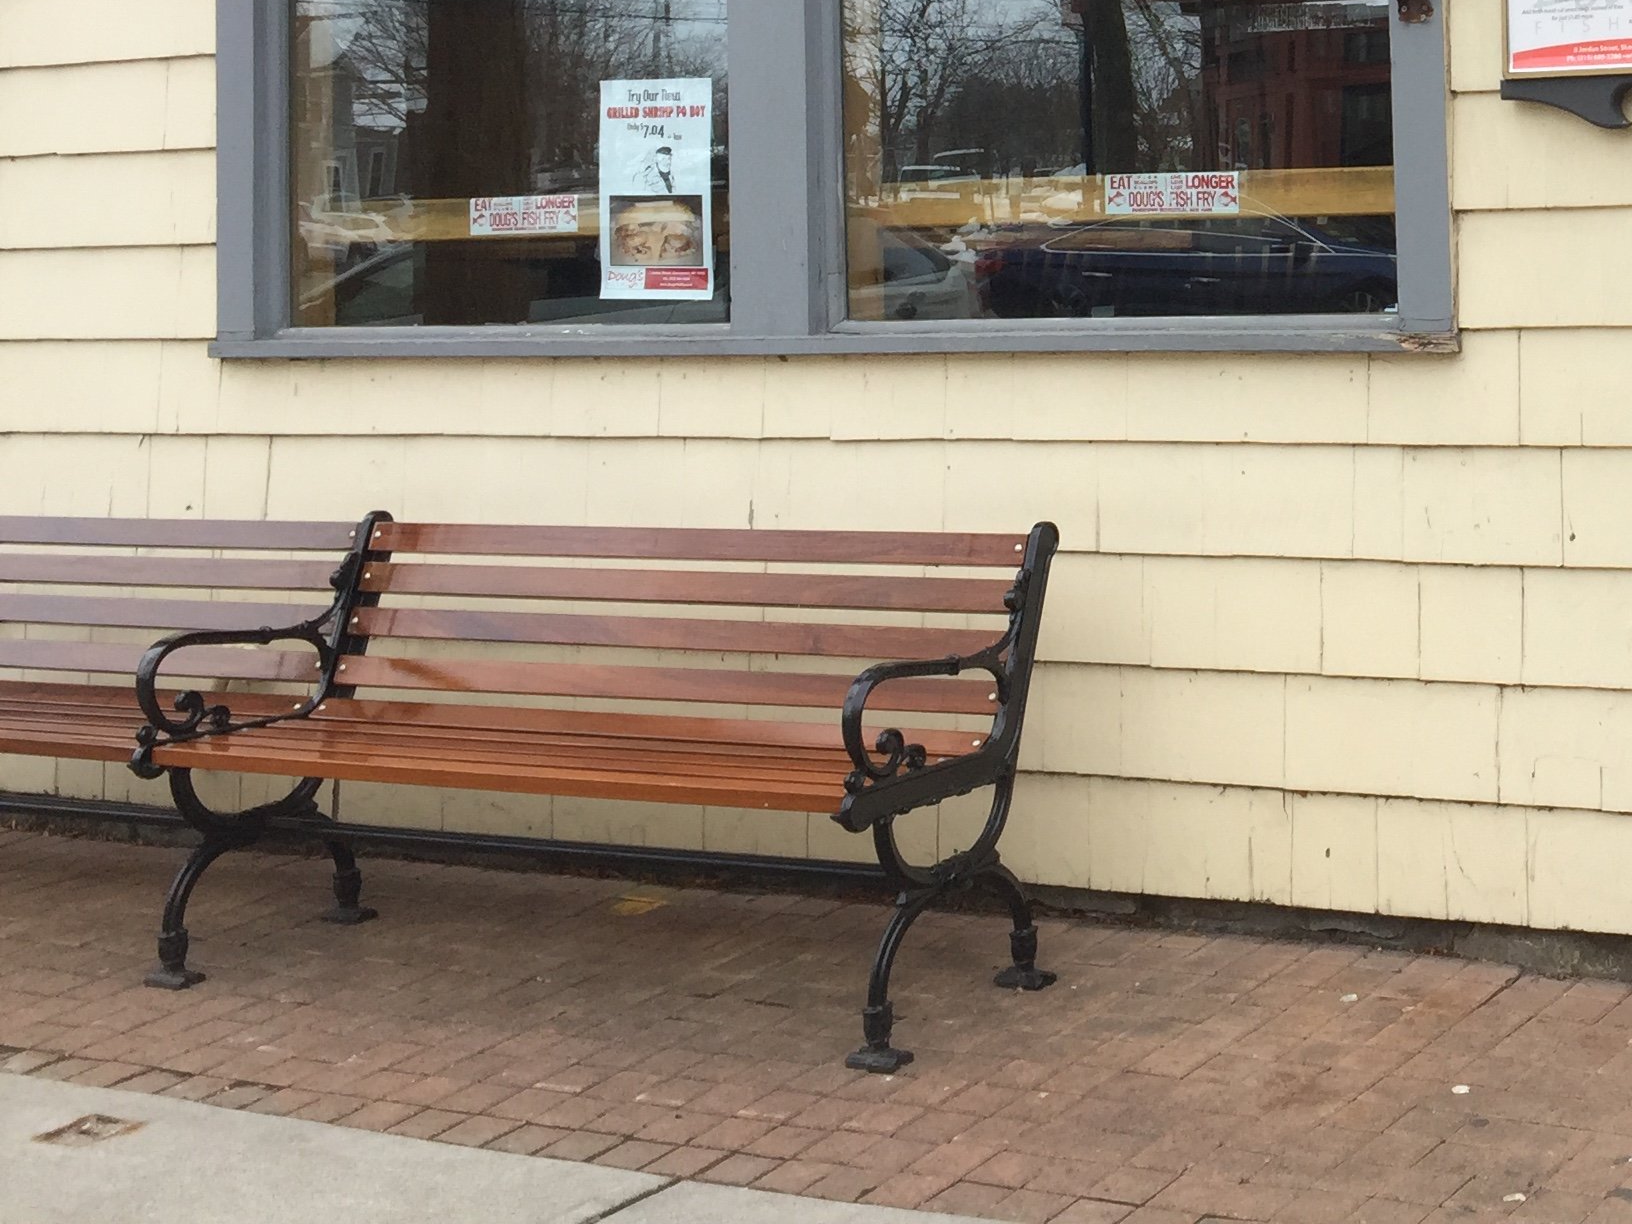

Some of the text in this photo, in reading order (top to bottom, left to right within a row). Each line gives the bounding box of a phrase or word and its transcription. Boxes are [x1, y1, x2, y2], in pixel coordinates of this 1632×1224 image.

[627, 89, 641, 105] Try
[643, 89, 659, 102] Our
[607, 107, 640, 119] GRILLED
[1110, 175, 1132, 189] EAT
[1185, 174, 1235, 189] LONGER
[475, 198, 492, 211] EAT
[535, 195, 575, 210] LONGER
[1128, 190, 1217, 207] DOUG'S FISH FRY
[489, 210, 560, 227] DOUG'S FISH FRY
